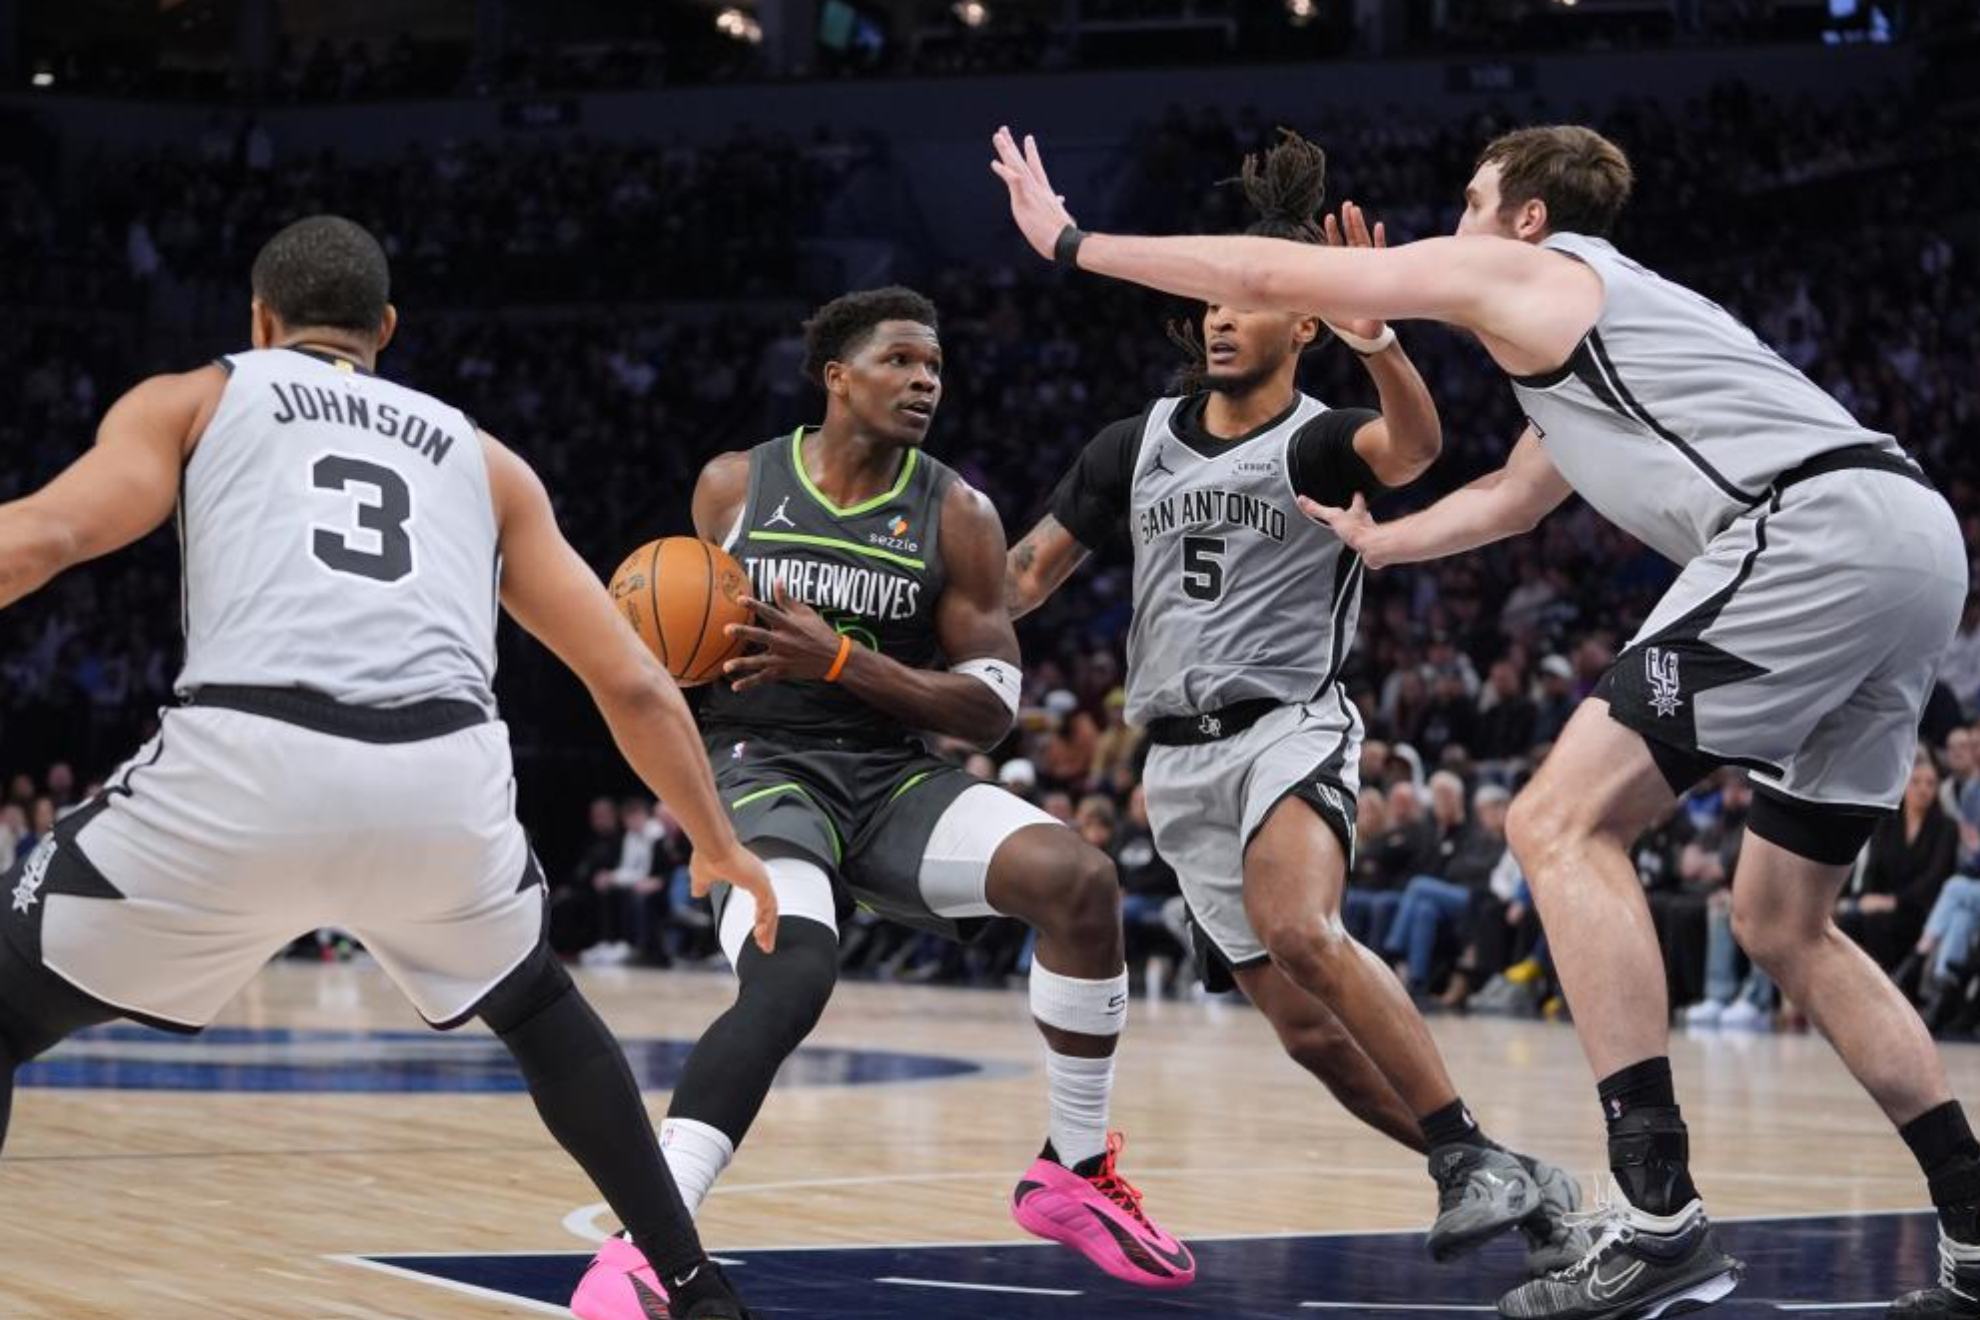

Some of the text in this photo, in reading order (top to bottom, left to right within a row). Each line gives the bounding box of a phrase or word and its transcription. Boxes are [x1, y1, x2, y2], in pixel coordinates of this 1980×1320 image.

[270, 382, 454, 466] JOHNSON
[311, 454, 413, 582] 3
[869, 533, 918, 552] sezzle
[1140, 491, 1285, 545] SAN ANTONIO
[744, 558, 920, 623] TIMBERWOLVES
[1183, 537, 1226, 601] 5
